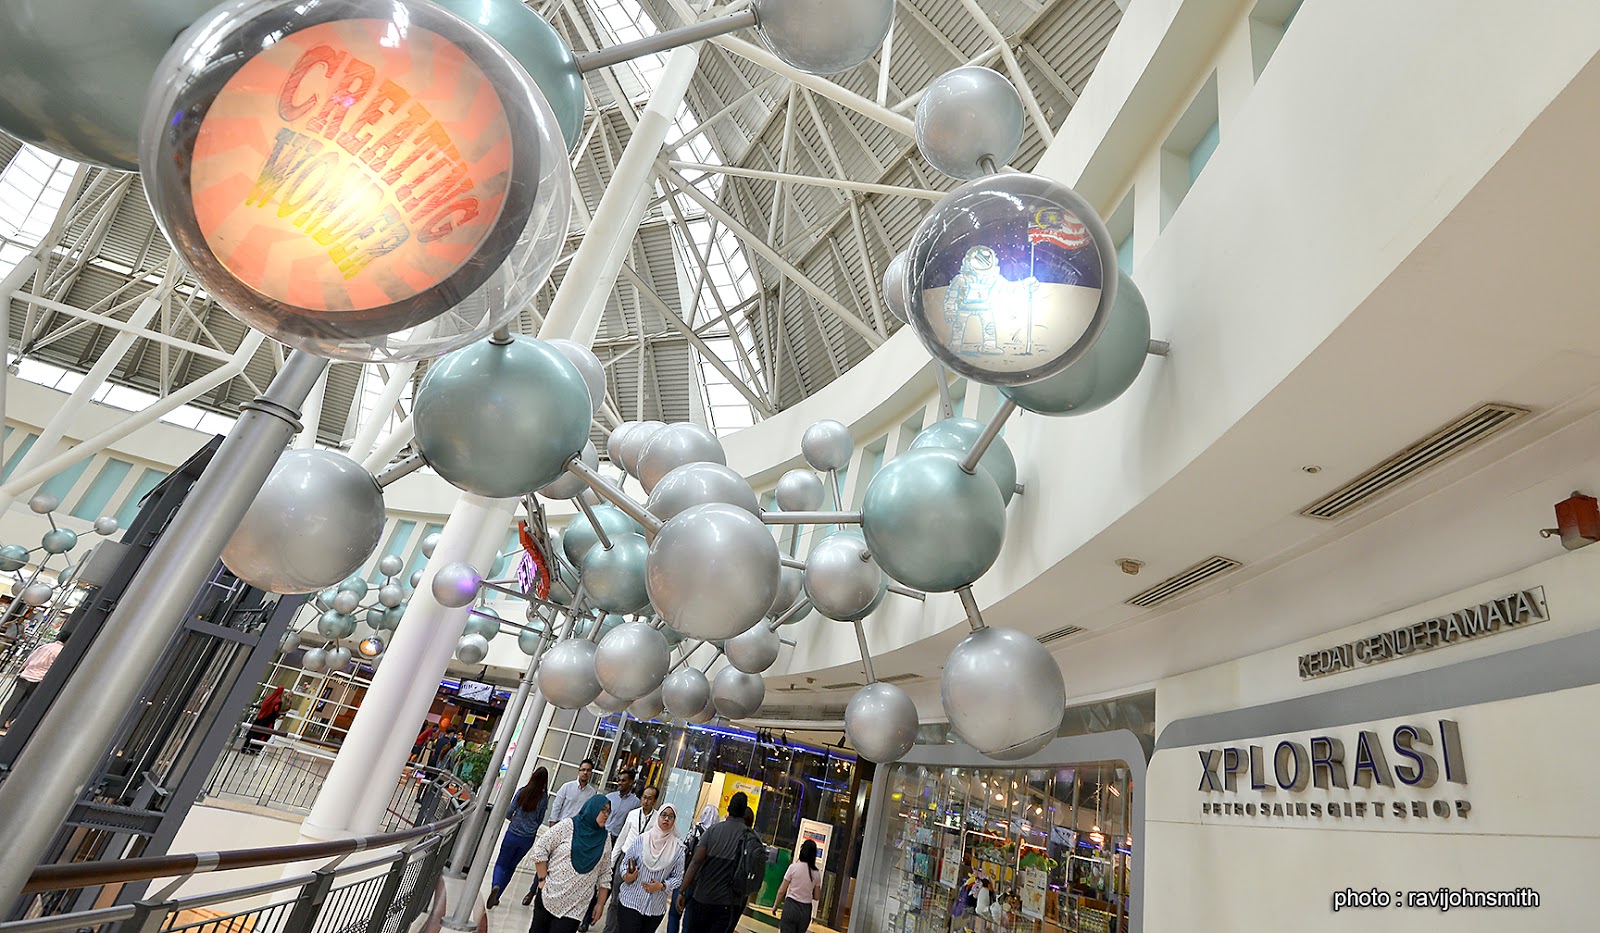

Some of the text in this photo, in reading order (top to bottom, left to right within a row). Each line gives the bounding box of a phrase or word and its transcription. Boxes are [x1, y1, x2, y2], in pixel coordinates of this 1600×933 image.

[246, 127, 411, 281] WONDER
[277, 44, 481, 244] CREATING
[1298, 590, 1543, 678] KEDAI CENDERAMATA
[1198, 719, 1468, 793] XPLORASI
